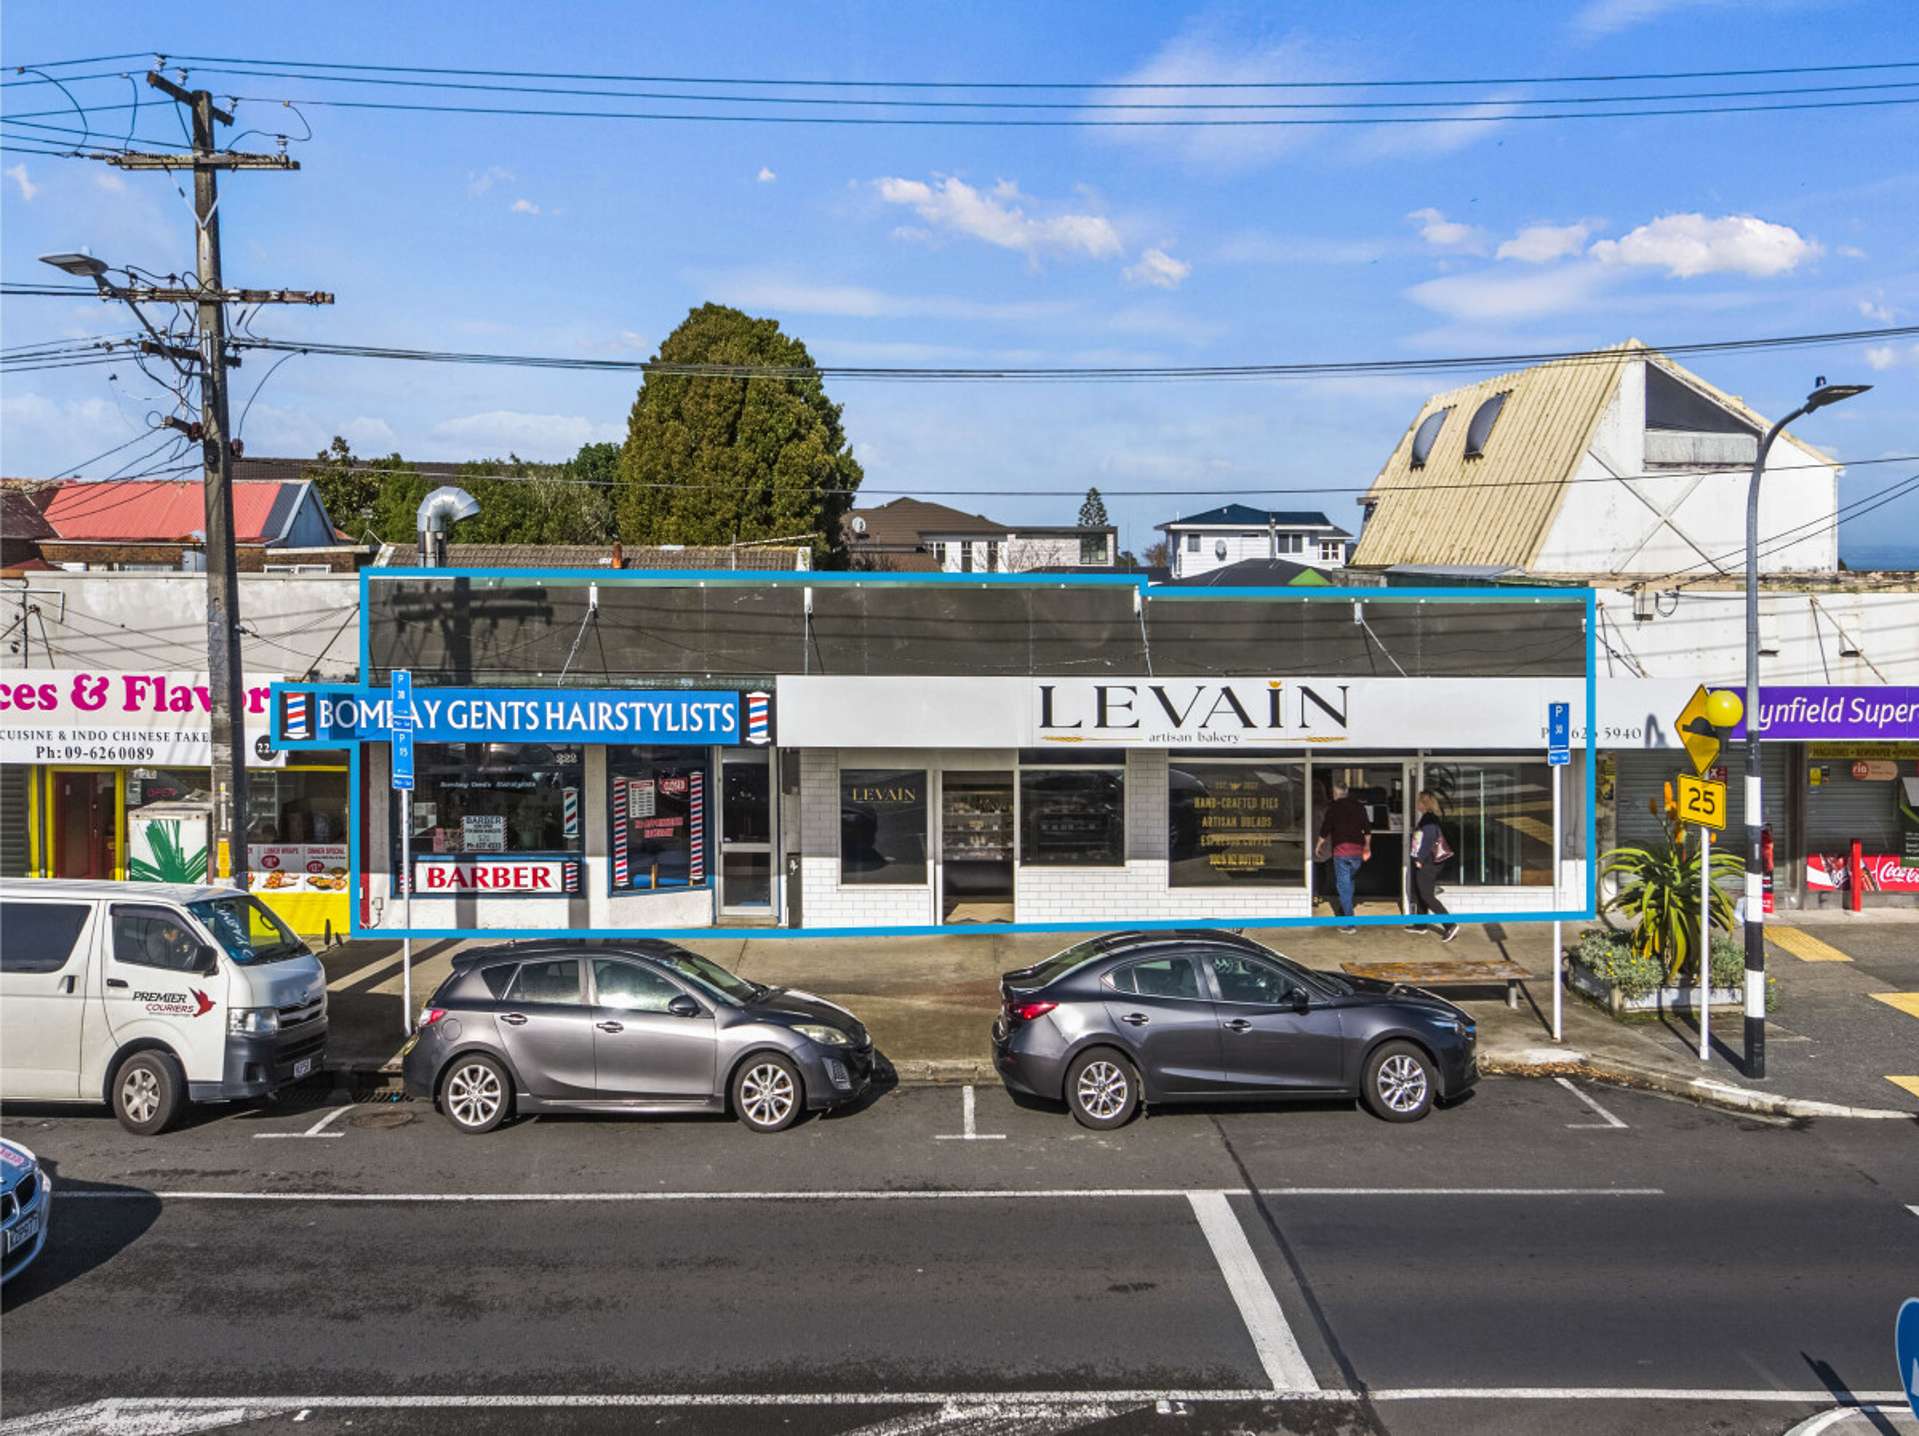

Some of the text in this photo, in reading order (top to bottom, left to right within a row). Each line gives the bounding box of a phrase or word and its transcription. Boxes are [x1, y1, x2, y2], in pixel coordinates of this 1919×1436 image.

[71, 673, 110, 711] &
[122, 675, 270, 713] Flavr
[1039, 682, 1350, 728] LEVAIN
[1555, 705, 1563, 718] P
[447, 700, 539, 730] GENTS
[545, 701, 735, 732] HAIRSTYLISTS
[1759, 696, 1845, 731] ynfield
[58, 730, 66, 741] &
[72, 730, 108, 741] INDO
[113, 731, 170, 742] CHINESE
[175, 732, 211, 743] TAKE
[1149, 732, 1241, 745] artisan bakery
[1604, 727, 1642, 740] 5940
[853, 788, 915, 801] LEVAIN
[1688, 788, 1715, 815] 25
[427, 867, 552, 888] BARBER
[133, 991, 188, 1003] PREMIER
[145, 1004, 194, 1013] COURIERS
